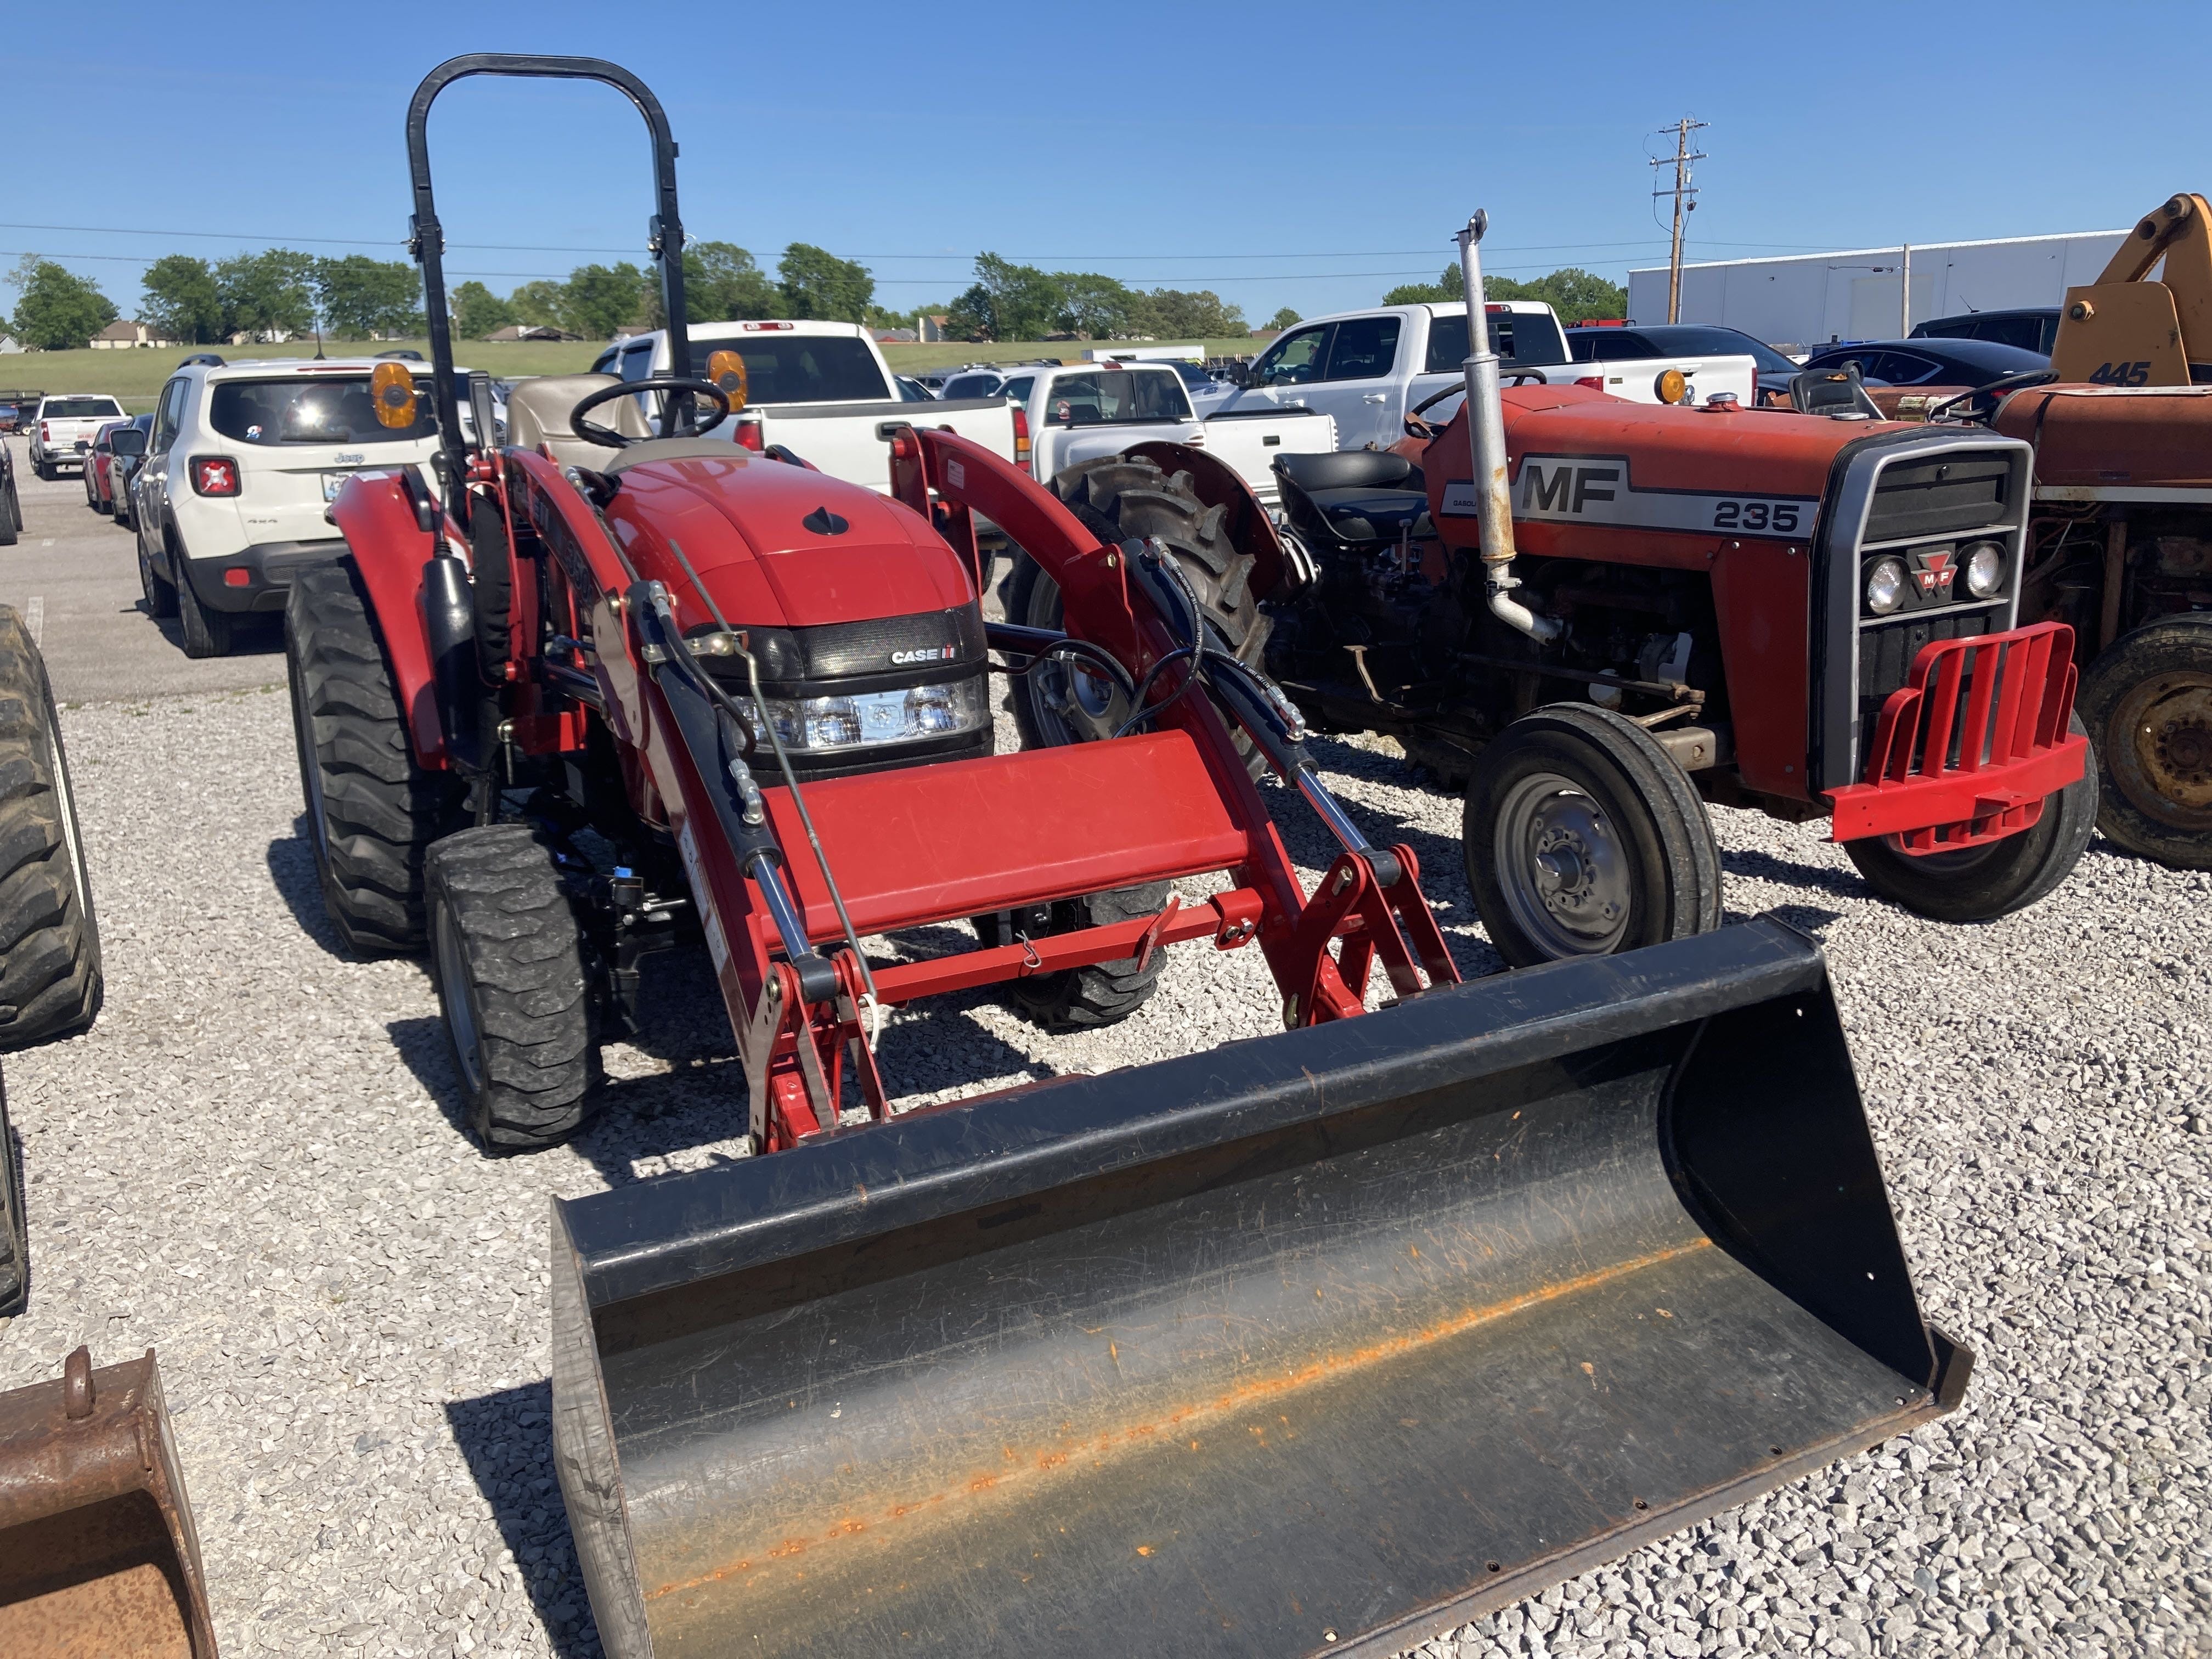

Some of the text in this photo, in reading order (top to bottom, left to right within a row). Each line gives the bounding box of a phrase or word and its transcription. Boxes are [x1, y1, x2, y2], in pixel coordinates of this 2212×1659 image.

[2089, 362, 2151, 387] 445
[335, 453, 364, 465] Jeep
[1522, 465, 1620, 513] MF
[1713, 501, 1799, 532] 235
[891, 649, 938, 664] CASE
